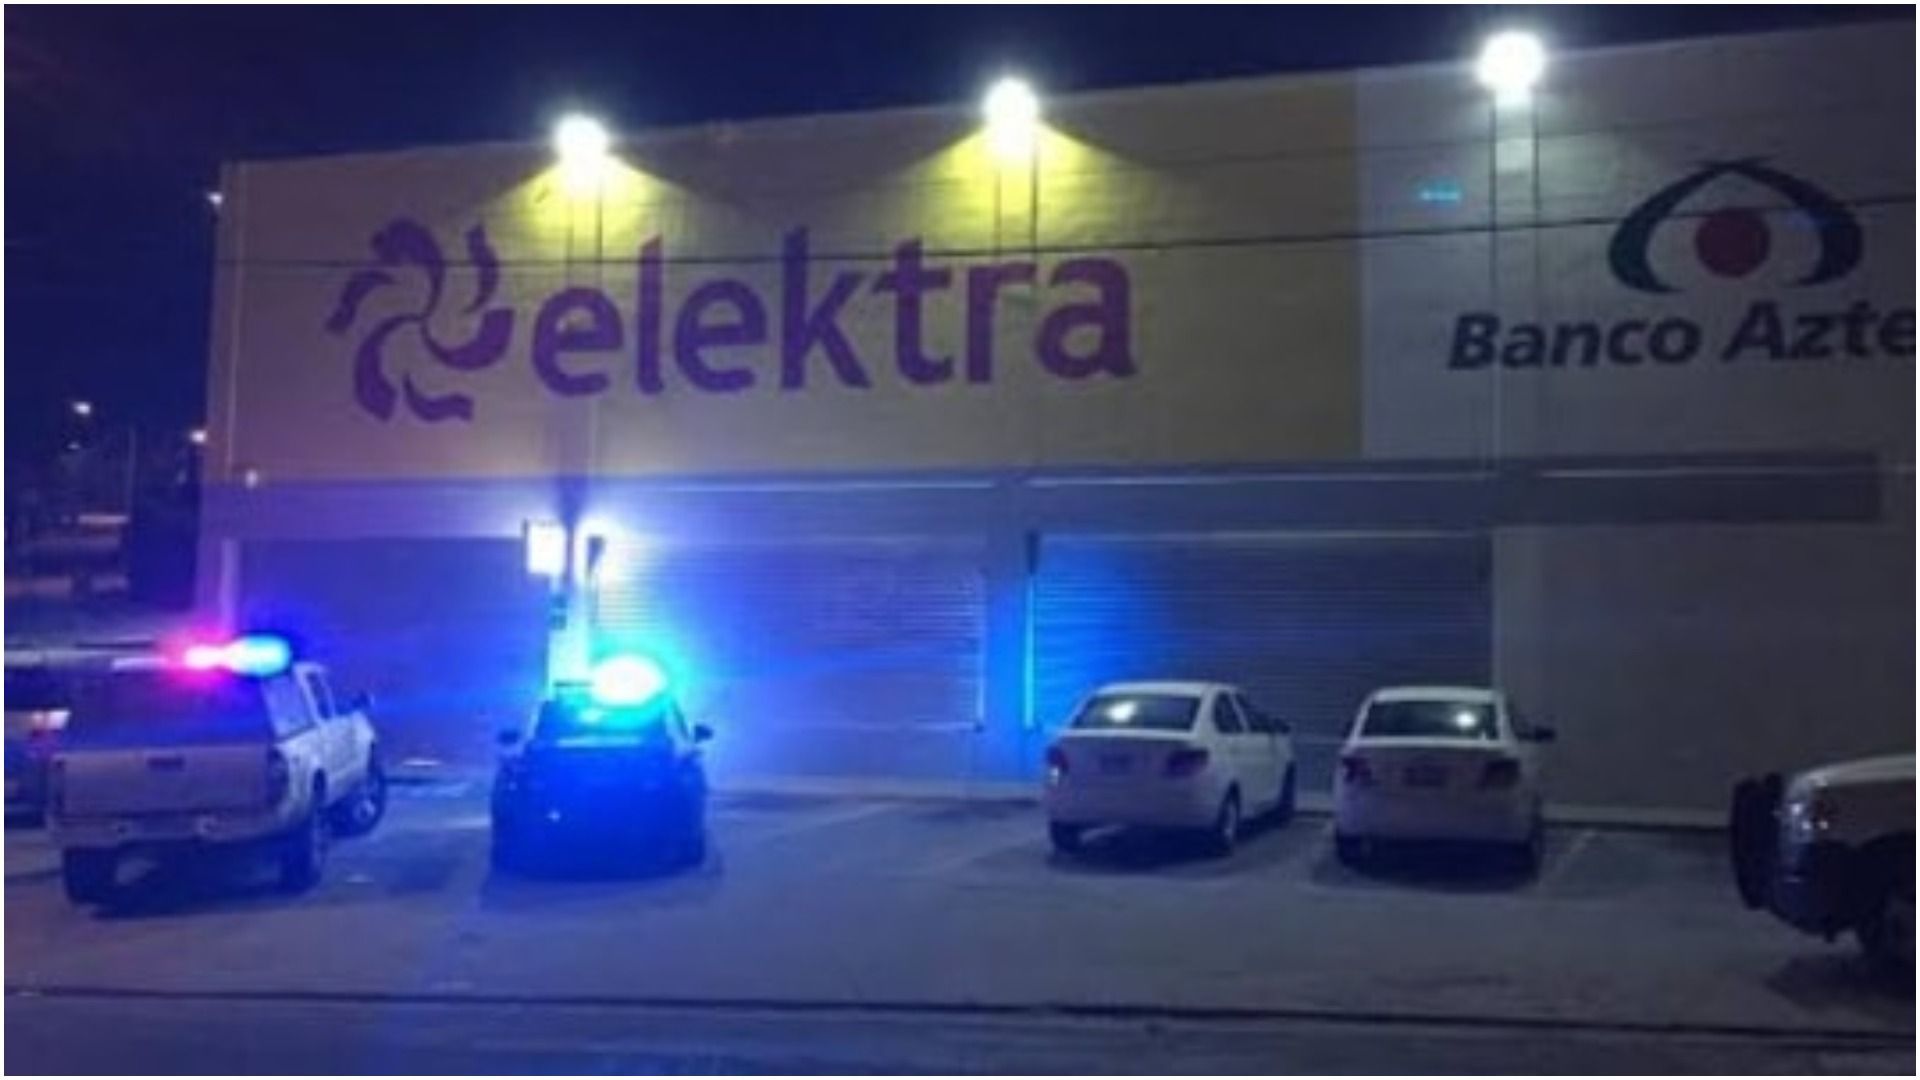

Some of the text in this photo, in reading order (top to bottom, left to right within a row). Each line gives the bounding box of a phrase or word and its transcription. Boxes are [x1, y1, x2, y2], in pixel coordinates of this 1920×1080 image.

[531, 225, 1138, 397] elektra
[1448, 300, 1916, 370] Banco Azte
